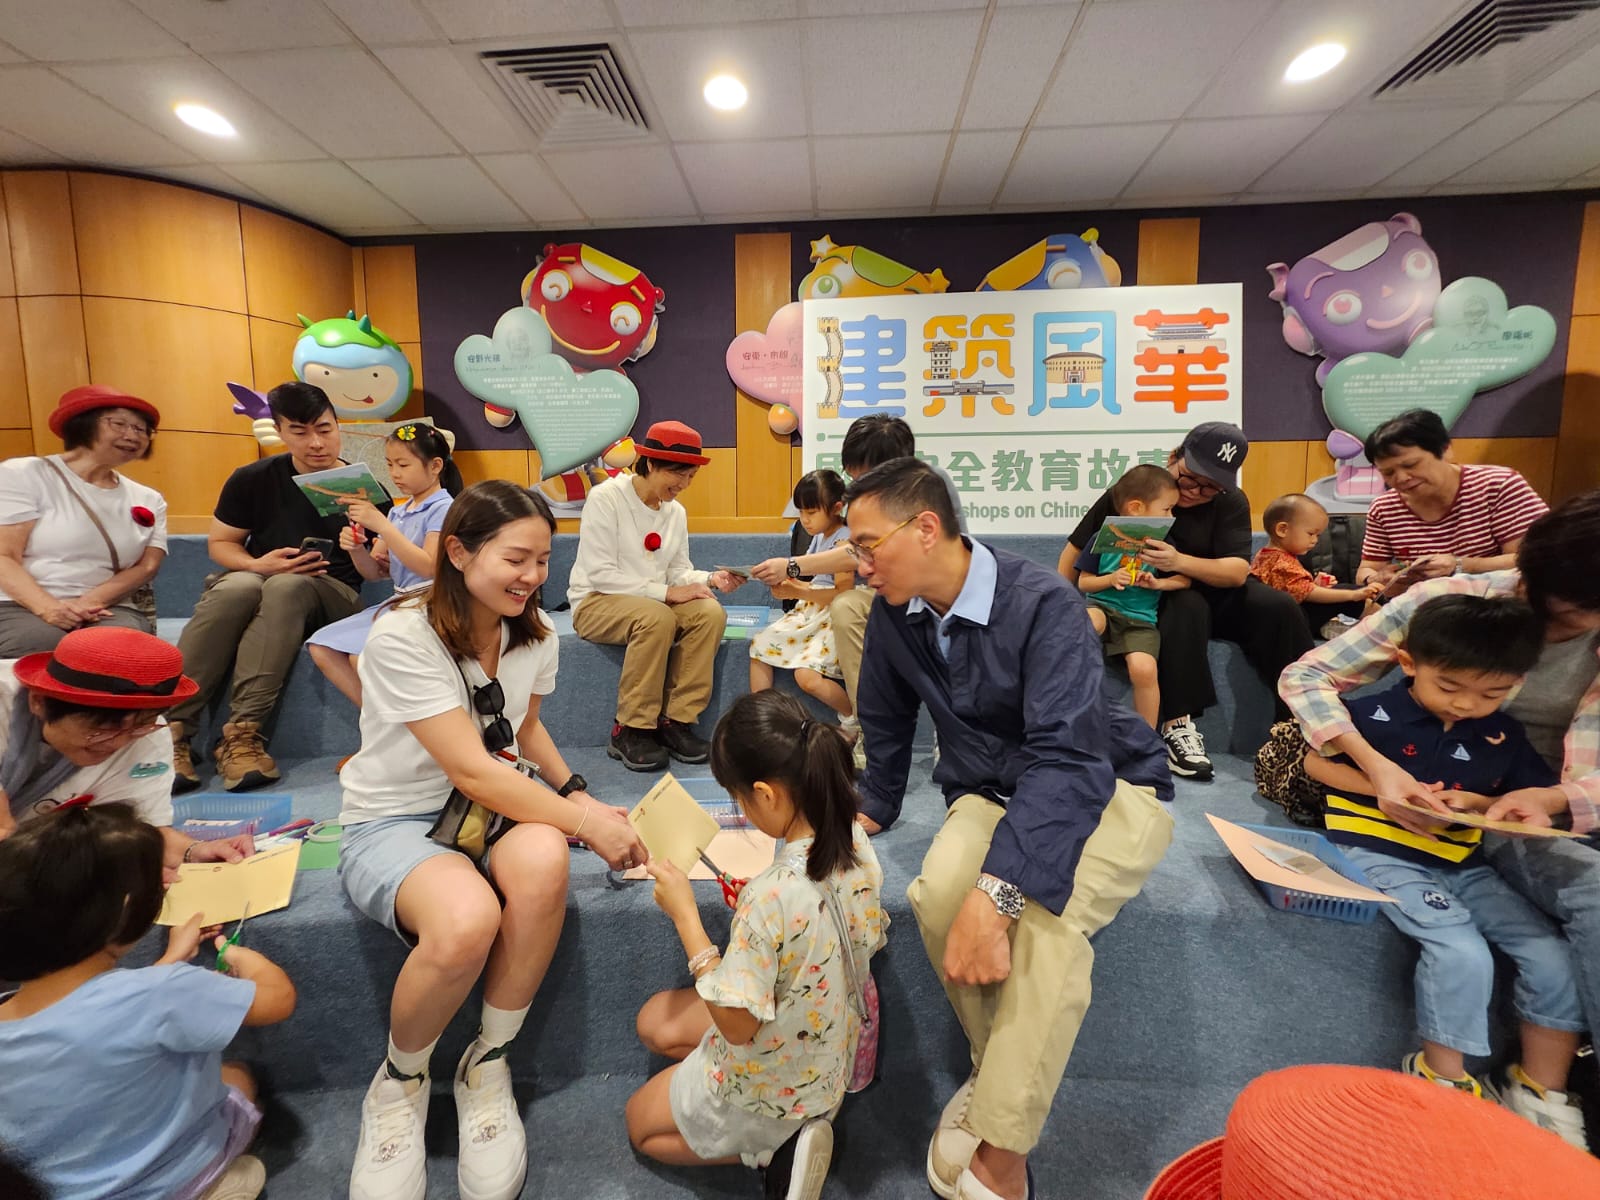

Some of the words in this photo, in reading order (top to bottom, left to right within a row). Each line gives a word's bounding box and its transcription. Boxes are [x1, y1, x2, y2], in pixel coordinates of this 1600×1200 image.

[816, 307, 1230, 419] 建築風華
[1217, 442, 1238, 463] NY
[961, 502, 1010, 522] shops
[1014, 505, 1036, 518] on
[1041, 501, 1090, 518] Chine
